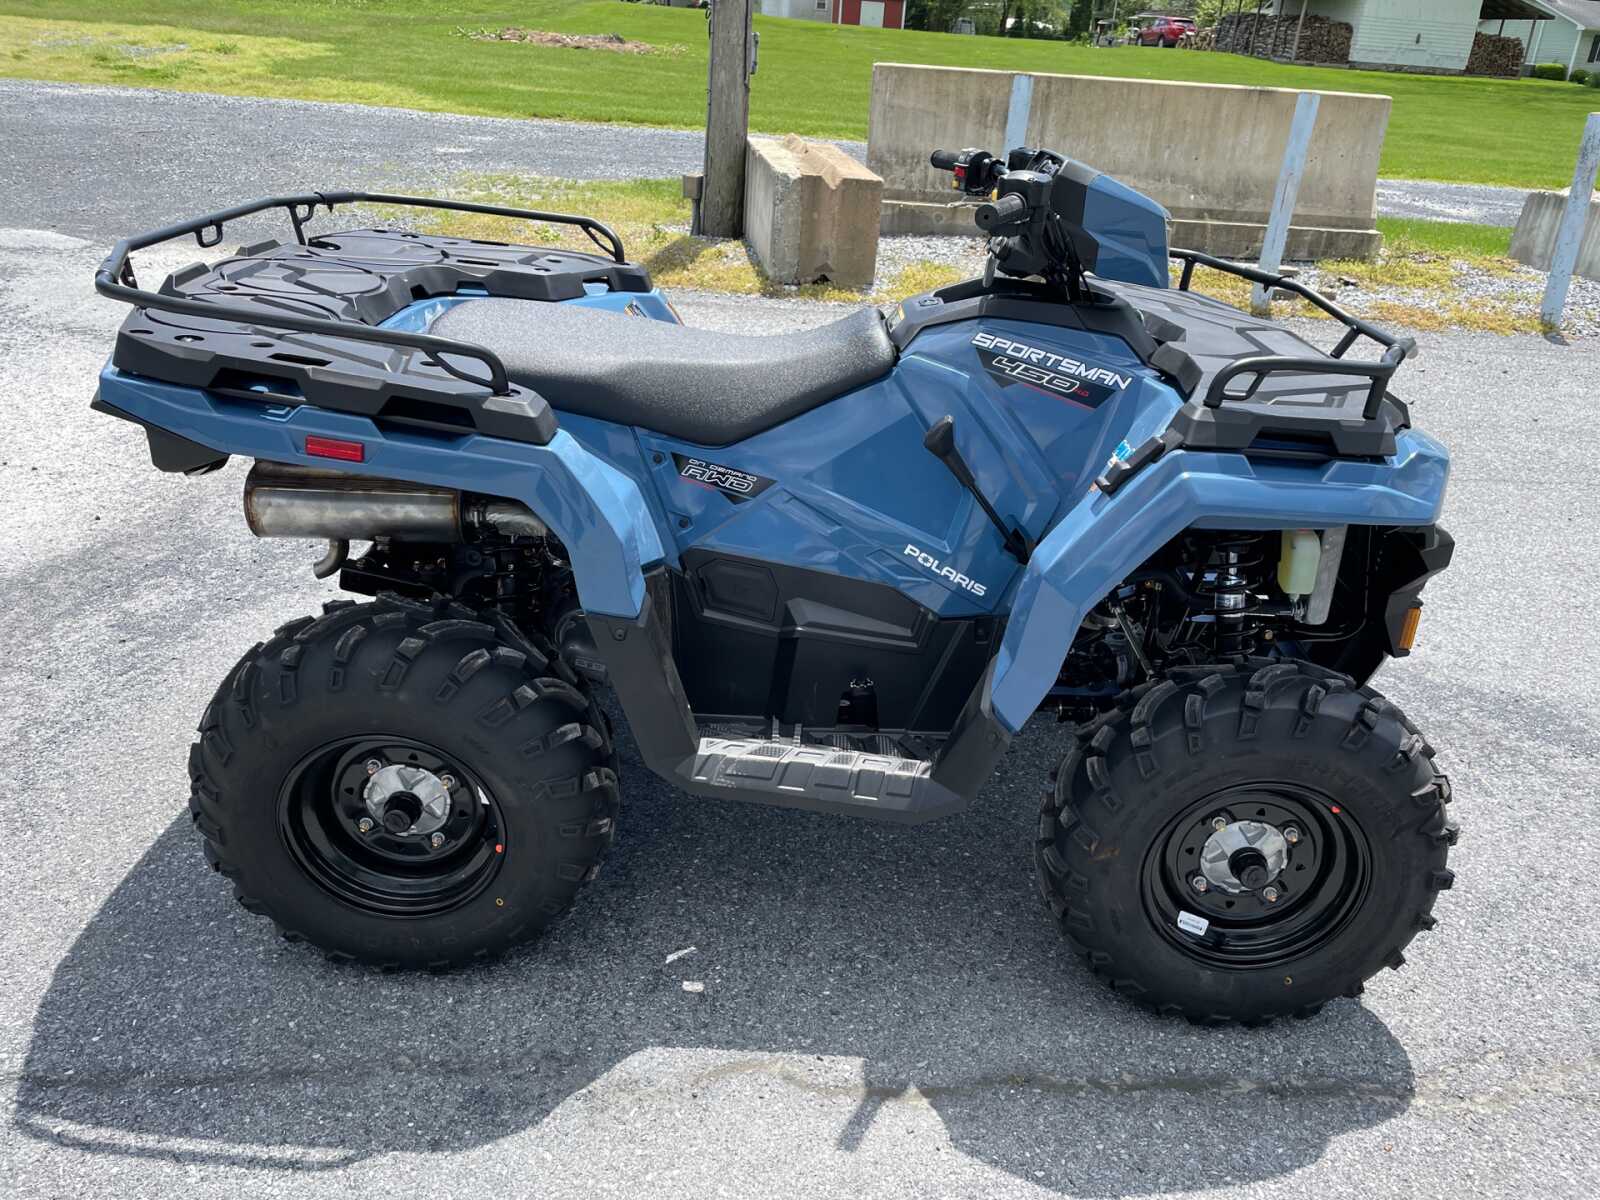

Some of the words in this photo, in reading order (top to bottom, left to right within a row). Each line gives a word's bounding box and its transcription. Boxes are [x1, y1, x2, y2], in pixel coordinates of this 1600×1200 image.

[971, 332, 1132, 390] SPORTSMAN
[992, 355, 1080, 393] 450
[681, 464, 754, 493] AWD
[688, 458, 706, 467] ON
[709, 464, 757, 482] DEMAND
[903, 543, 988, 597] POLARIS
